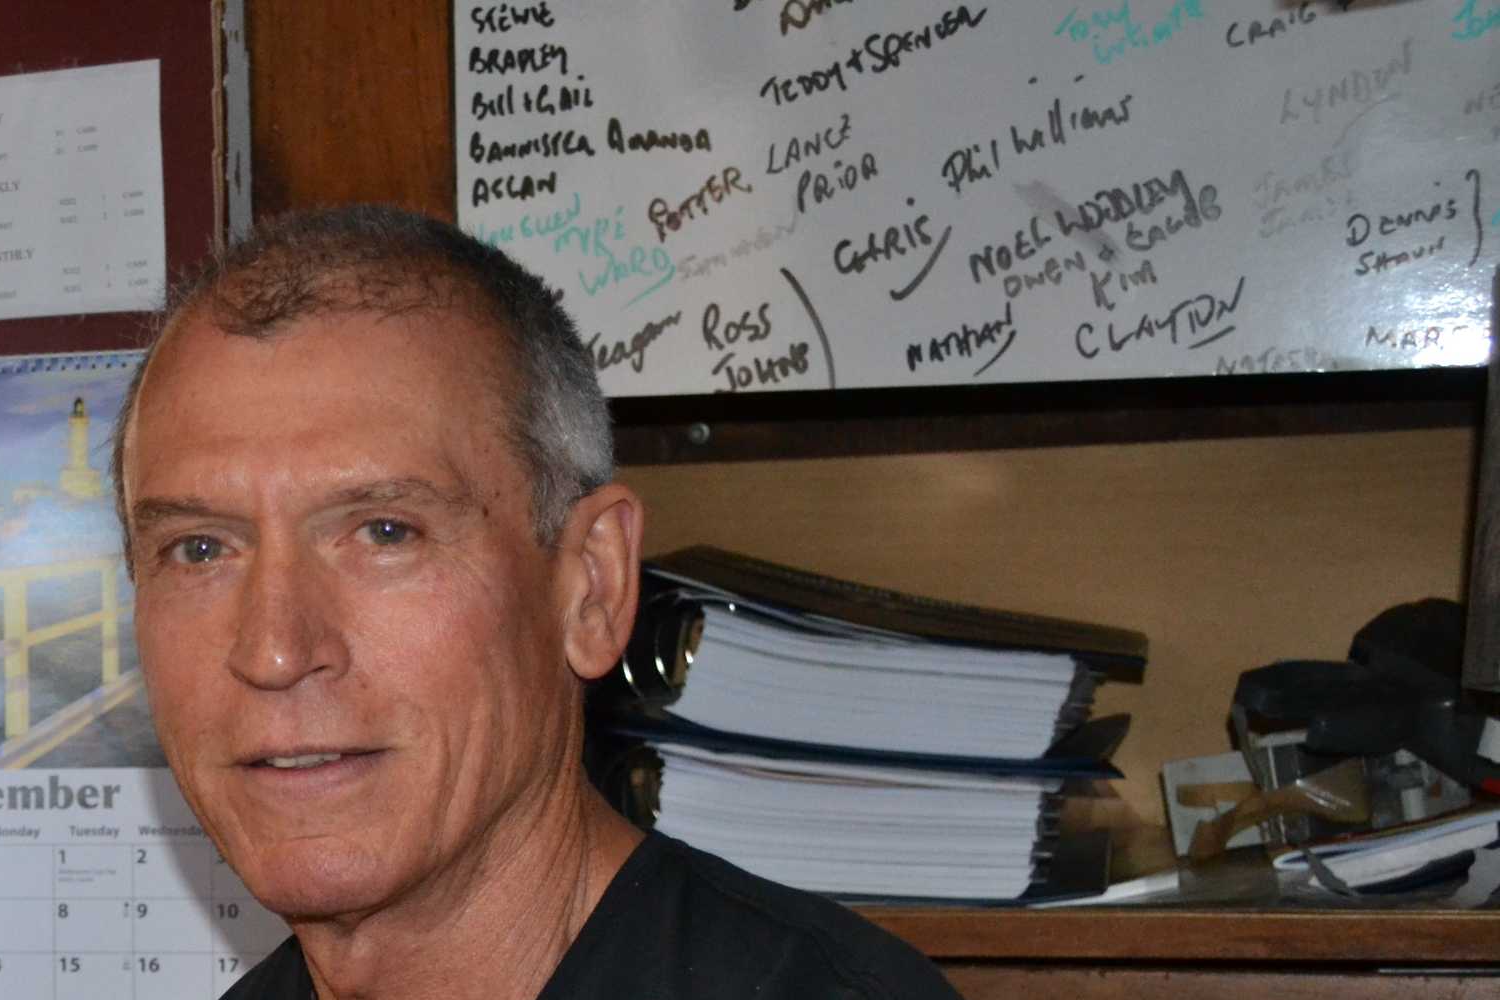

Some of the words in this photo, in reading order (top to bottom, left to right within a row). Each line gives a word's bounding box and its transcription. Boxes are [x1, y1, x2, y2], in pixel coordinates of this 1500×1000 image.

[1226, 11, 1317, 49] CRAIG
[759, 61, 848, 106] TEDDY
[702, 302, 772, 350] ROSS
[68, 824, 121, 839] Tuesday
[59, 849, 67, 864] 1
[136, 849, 148, 864] 2
[57, 904, 69, 918] 8
[136, 904, 148, 918] 9
[217, 904, 239, 918] 10
[58, 958, 81, 973] 15
[138, 958, 160, 973] 16
[219, 958, 239, 973] 17
